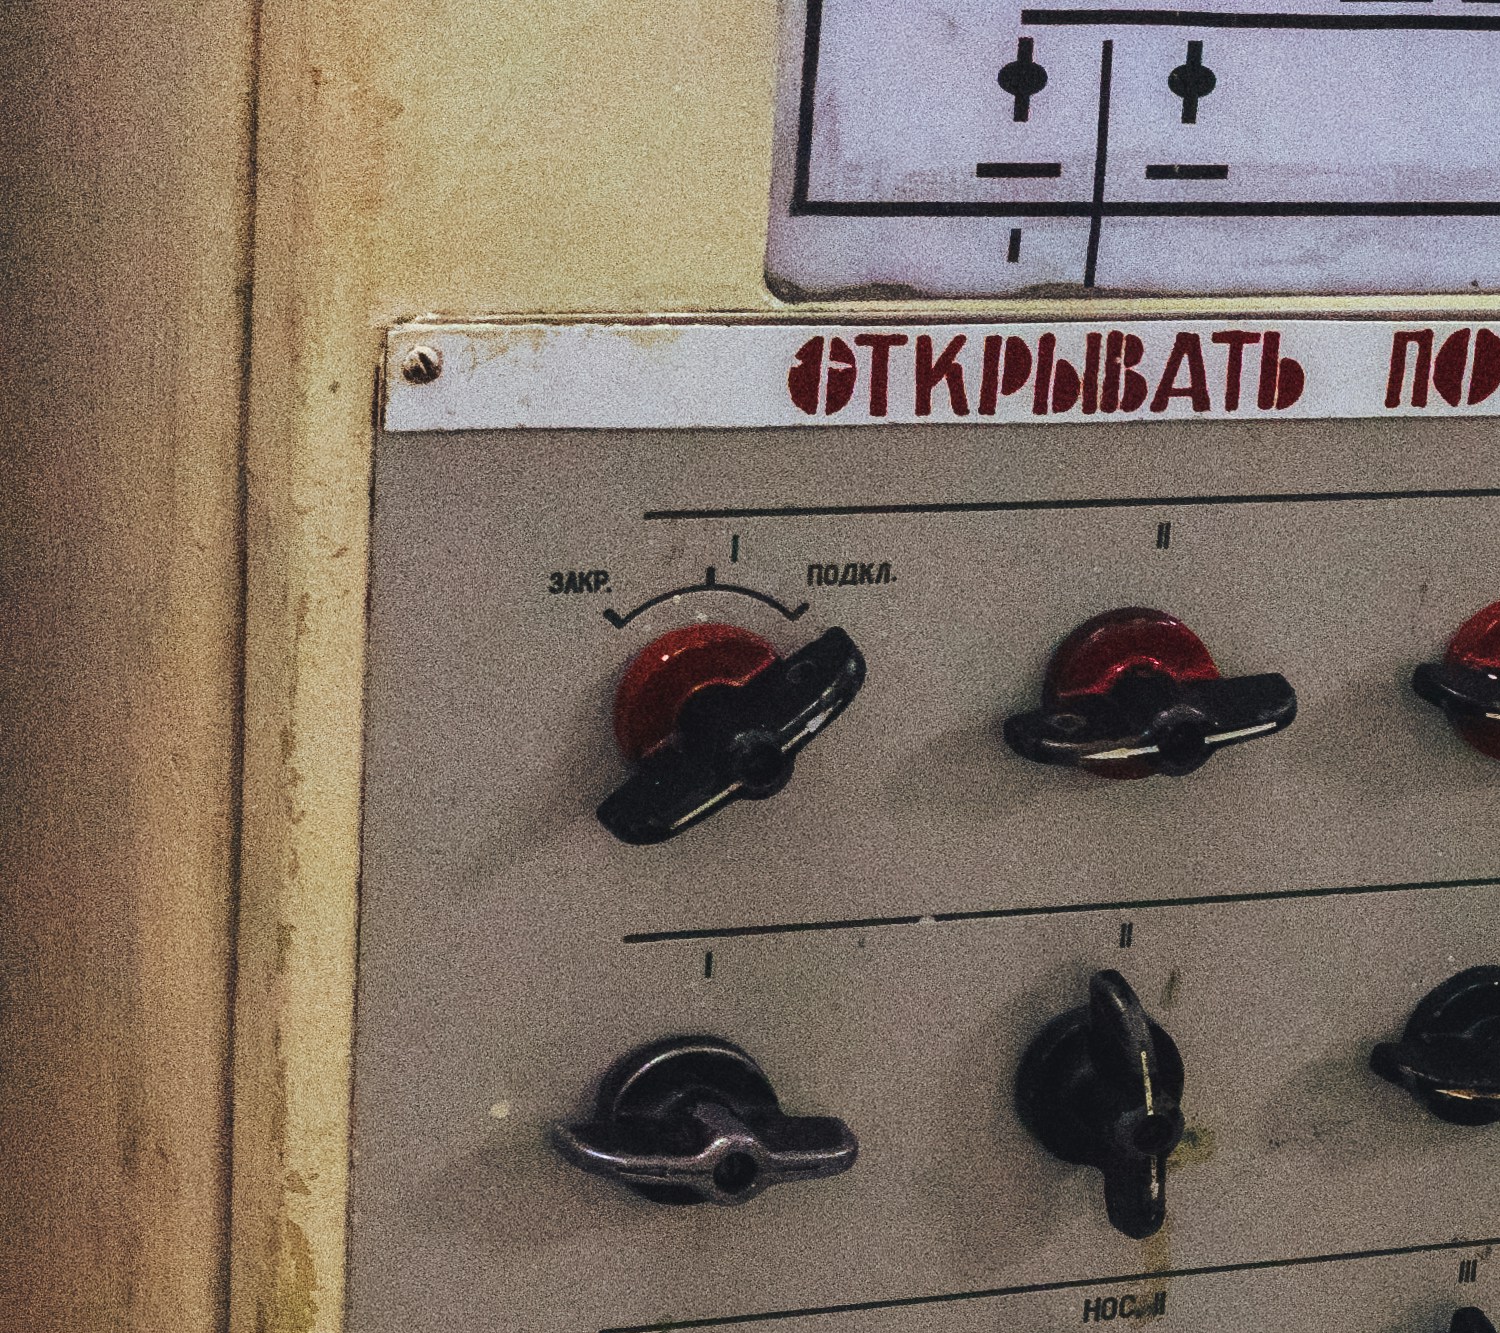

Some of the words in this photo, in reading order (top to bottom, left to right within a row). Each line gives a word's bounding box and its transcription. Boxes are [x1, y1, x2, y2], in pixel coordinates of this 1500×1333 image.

[788, 329, 1305, 416] ОТКРЫВАТЬ
[549, 569, 613, 595] ЗАКР.
[807, 562, 898, 588] ПОДКЛ.
